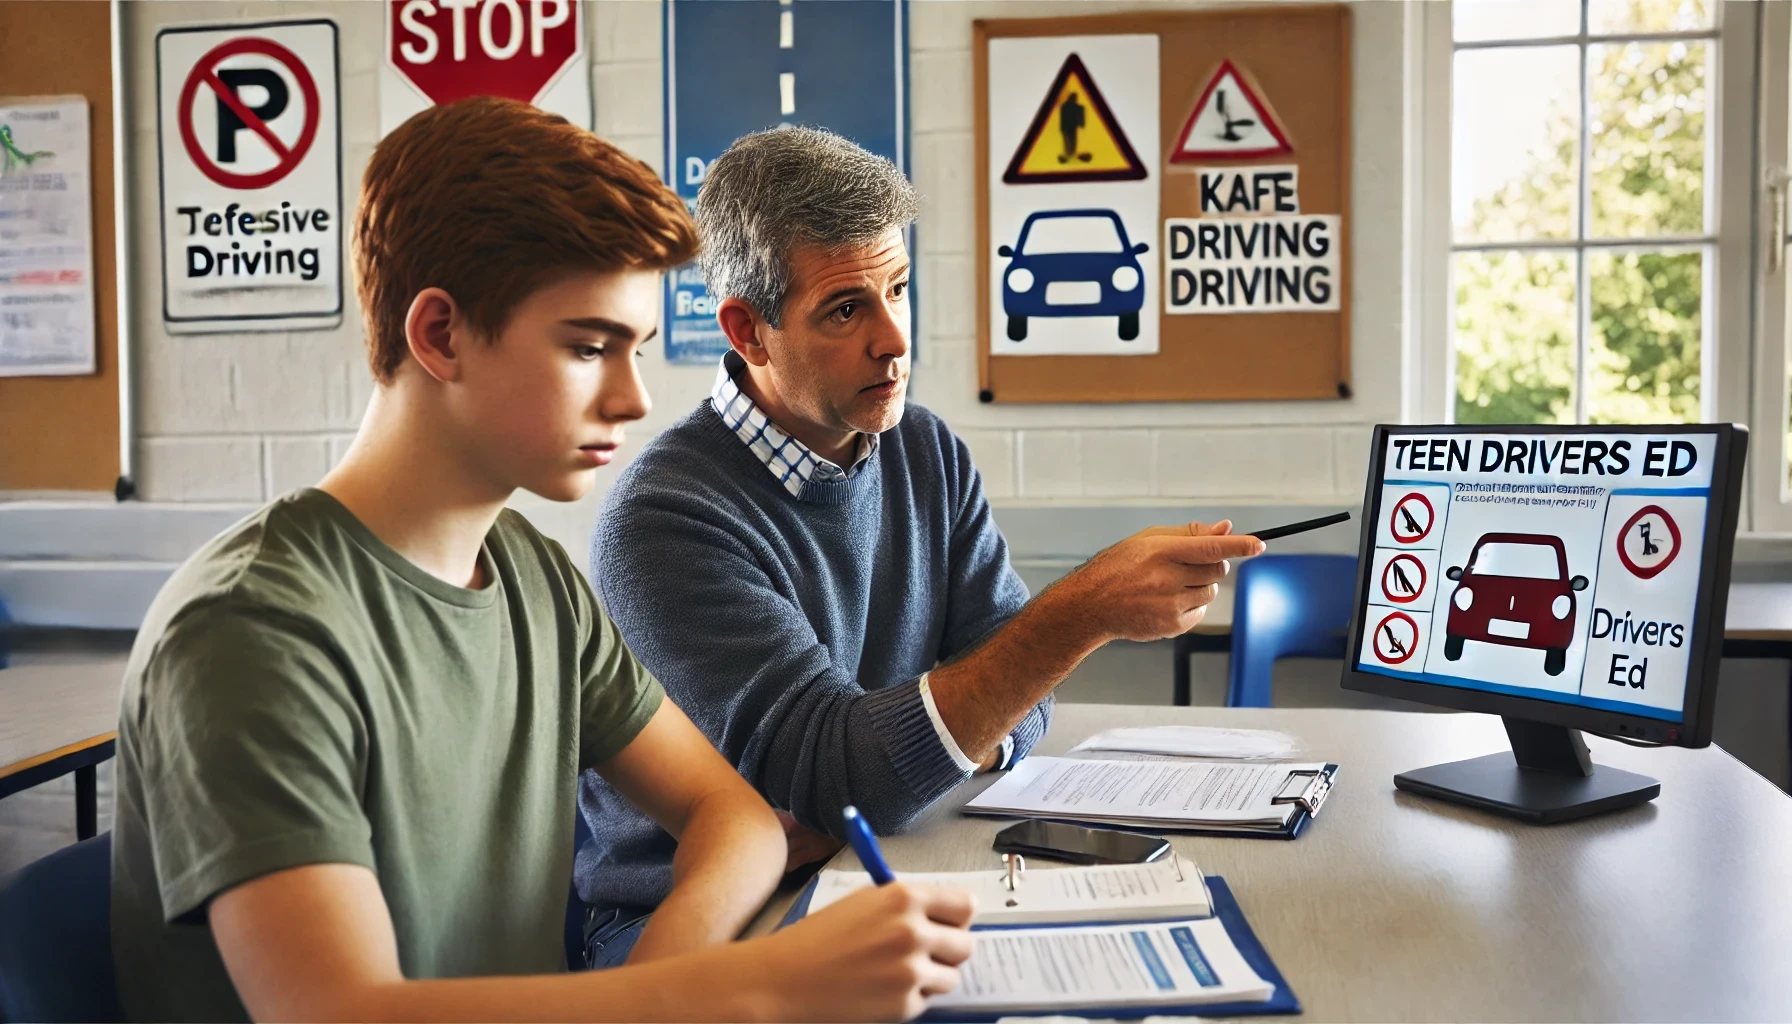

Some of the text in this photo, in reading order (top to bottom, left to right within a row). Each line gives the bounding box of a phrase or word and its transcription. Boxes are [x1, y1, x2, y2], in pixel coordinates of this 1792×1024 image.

[400, 0, 570, 64] STOP
[214, 68, 290, 163] P
[1201, 172, 1296, 212] KAFE
[186, 239, 320, 281] Driving
[1170, 221, 1329, 260] DRIVING
[1171, 266, 1331, 306] DRIVING
[1393, 439, 1698, 478] TEEN DRIVERS ED
[1591, 607, 1684, 648] Drivers
[1607, 653, 1648, 690] Ed
